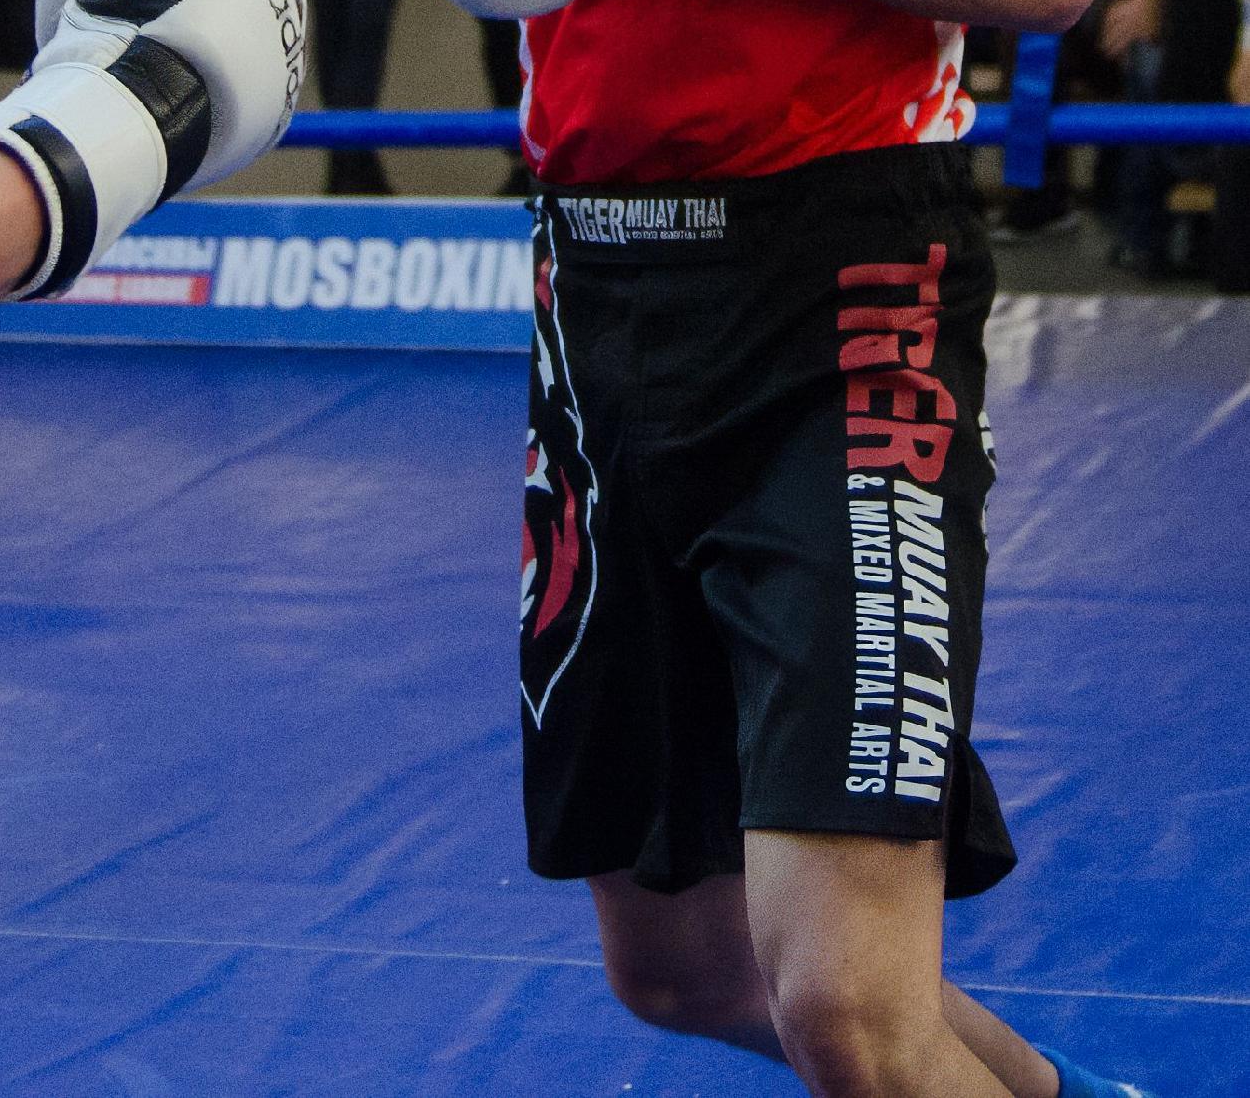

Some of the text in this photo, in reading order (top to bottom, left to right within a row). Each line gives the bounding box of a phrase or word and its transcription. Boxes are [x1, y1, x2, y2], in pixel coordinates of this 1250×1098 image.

[557, 197, 727, 244] TIGER MUAY THAI
[836, 242, 958, 803] TIGER MUAY THAI
[844, 473, 897, 794] & MIXED MARTIAL ARTS
